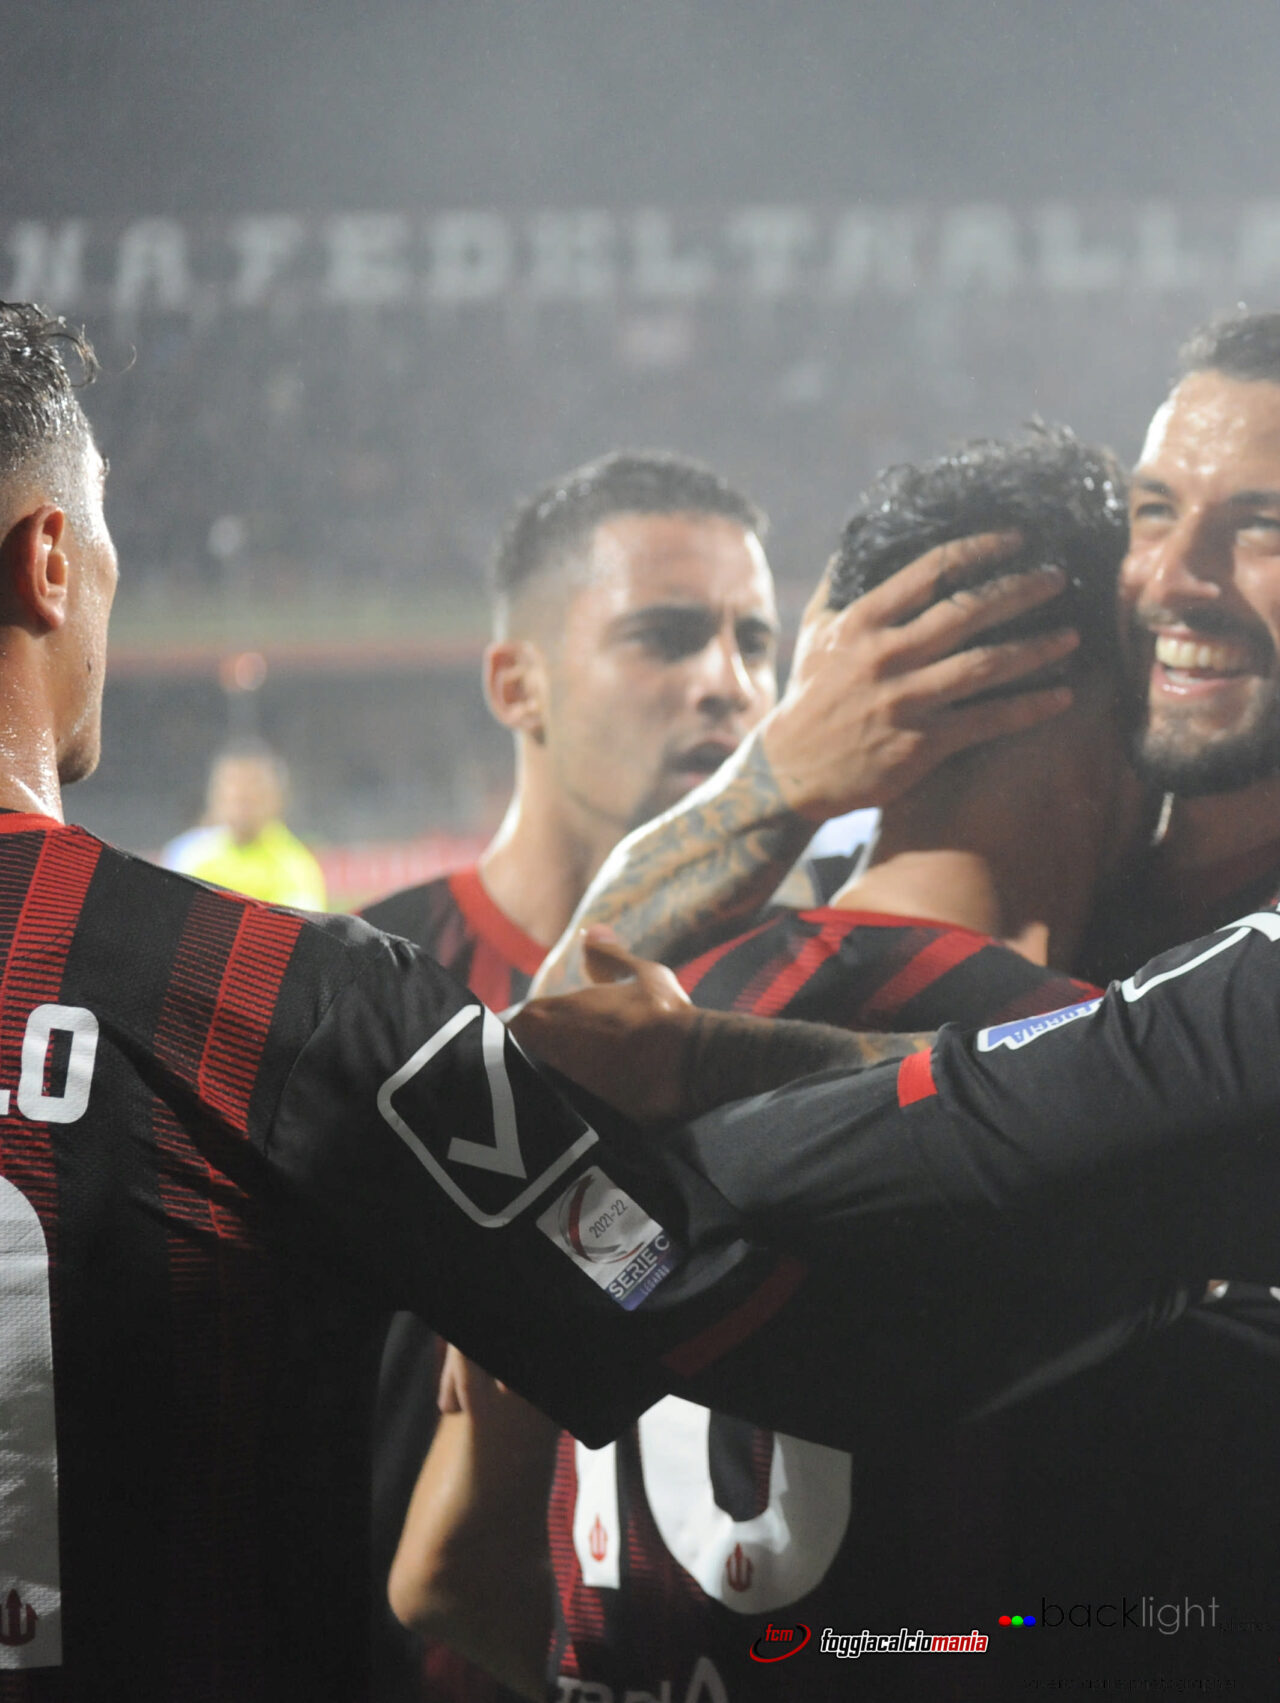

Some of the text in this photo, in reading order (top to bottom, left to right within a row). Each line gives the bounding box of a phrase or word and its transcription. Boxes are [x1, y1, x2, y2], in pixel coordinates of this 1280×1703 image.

[589, 1200, 627, 1238] 2021-22
[609, 1235, 670, 1298] SERIE C
